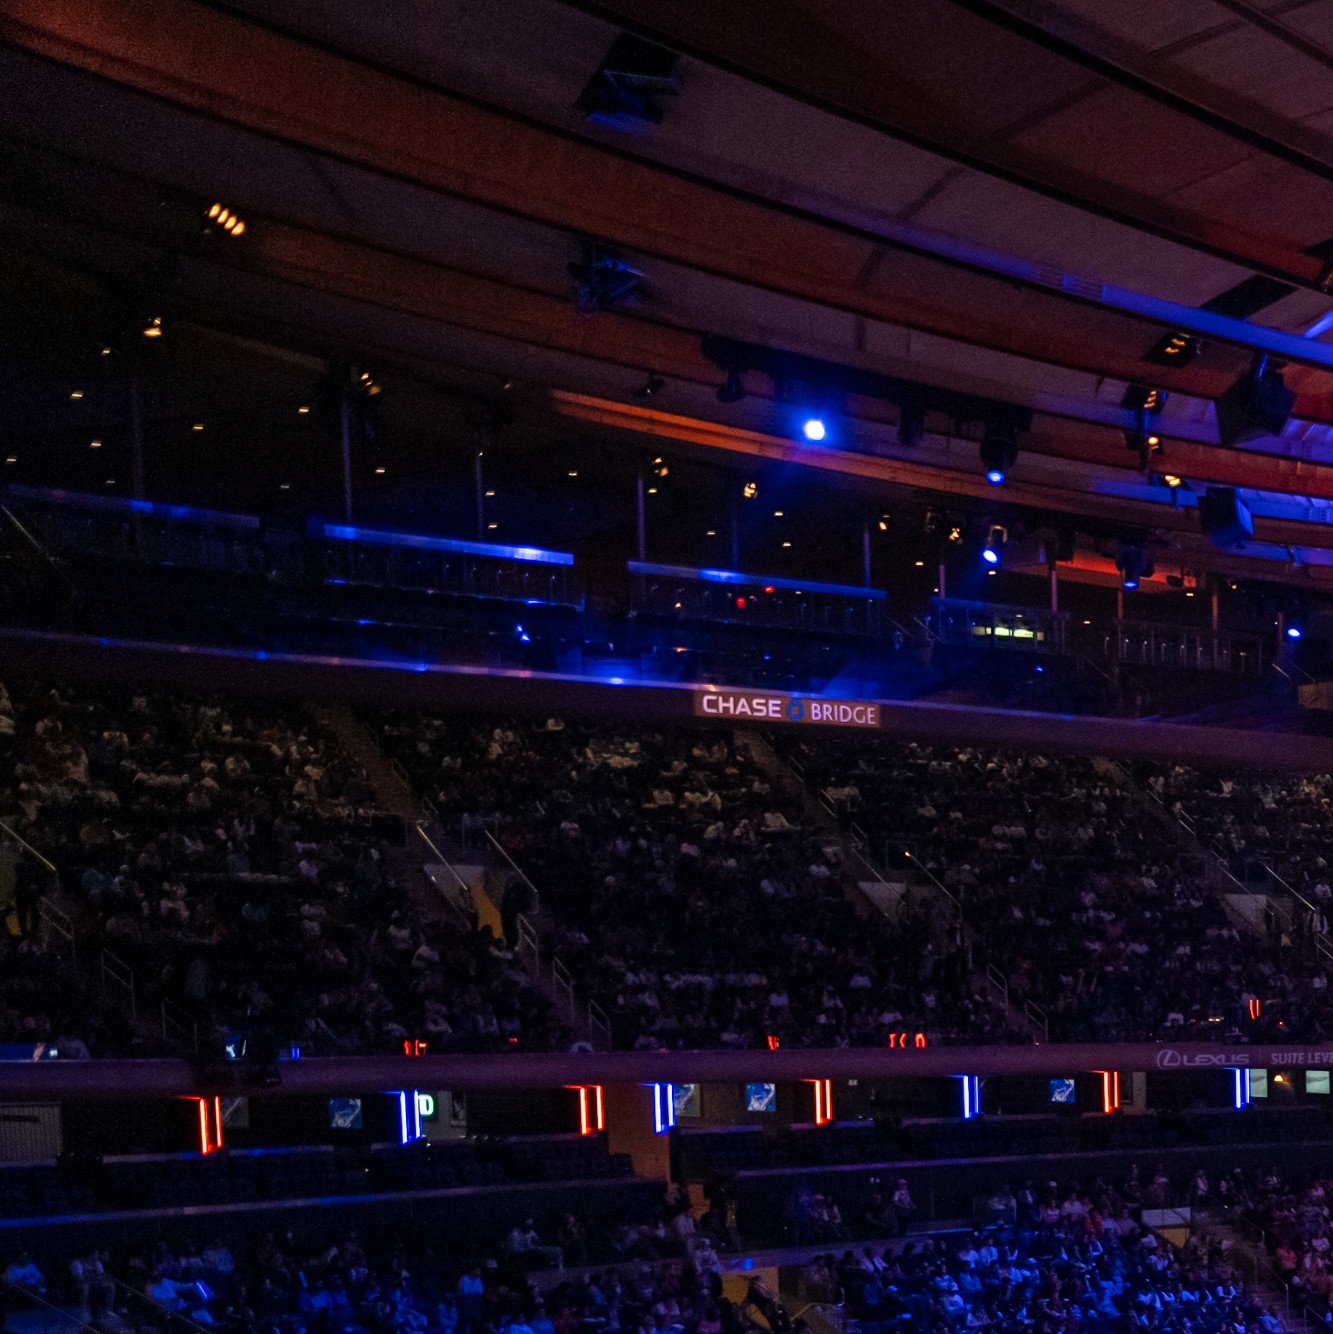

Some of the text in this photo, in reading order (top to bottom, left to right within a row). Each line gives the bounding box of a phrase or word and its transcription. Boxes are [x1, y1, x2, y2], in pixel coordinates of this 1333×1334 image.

[703, 696, 876, 724] CHASE BRIDGE
[1183, 1054, 1250, 1066] LEXUS
[1270, 1052, 1304, 1065] SUITE
